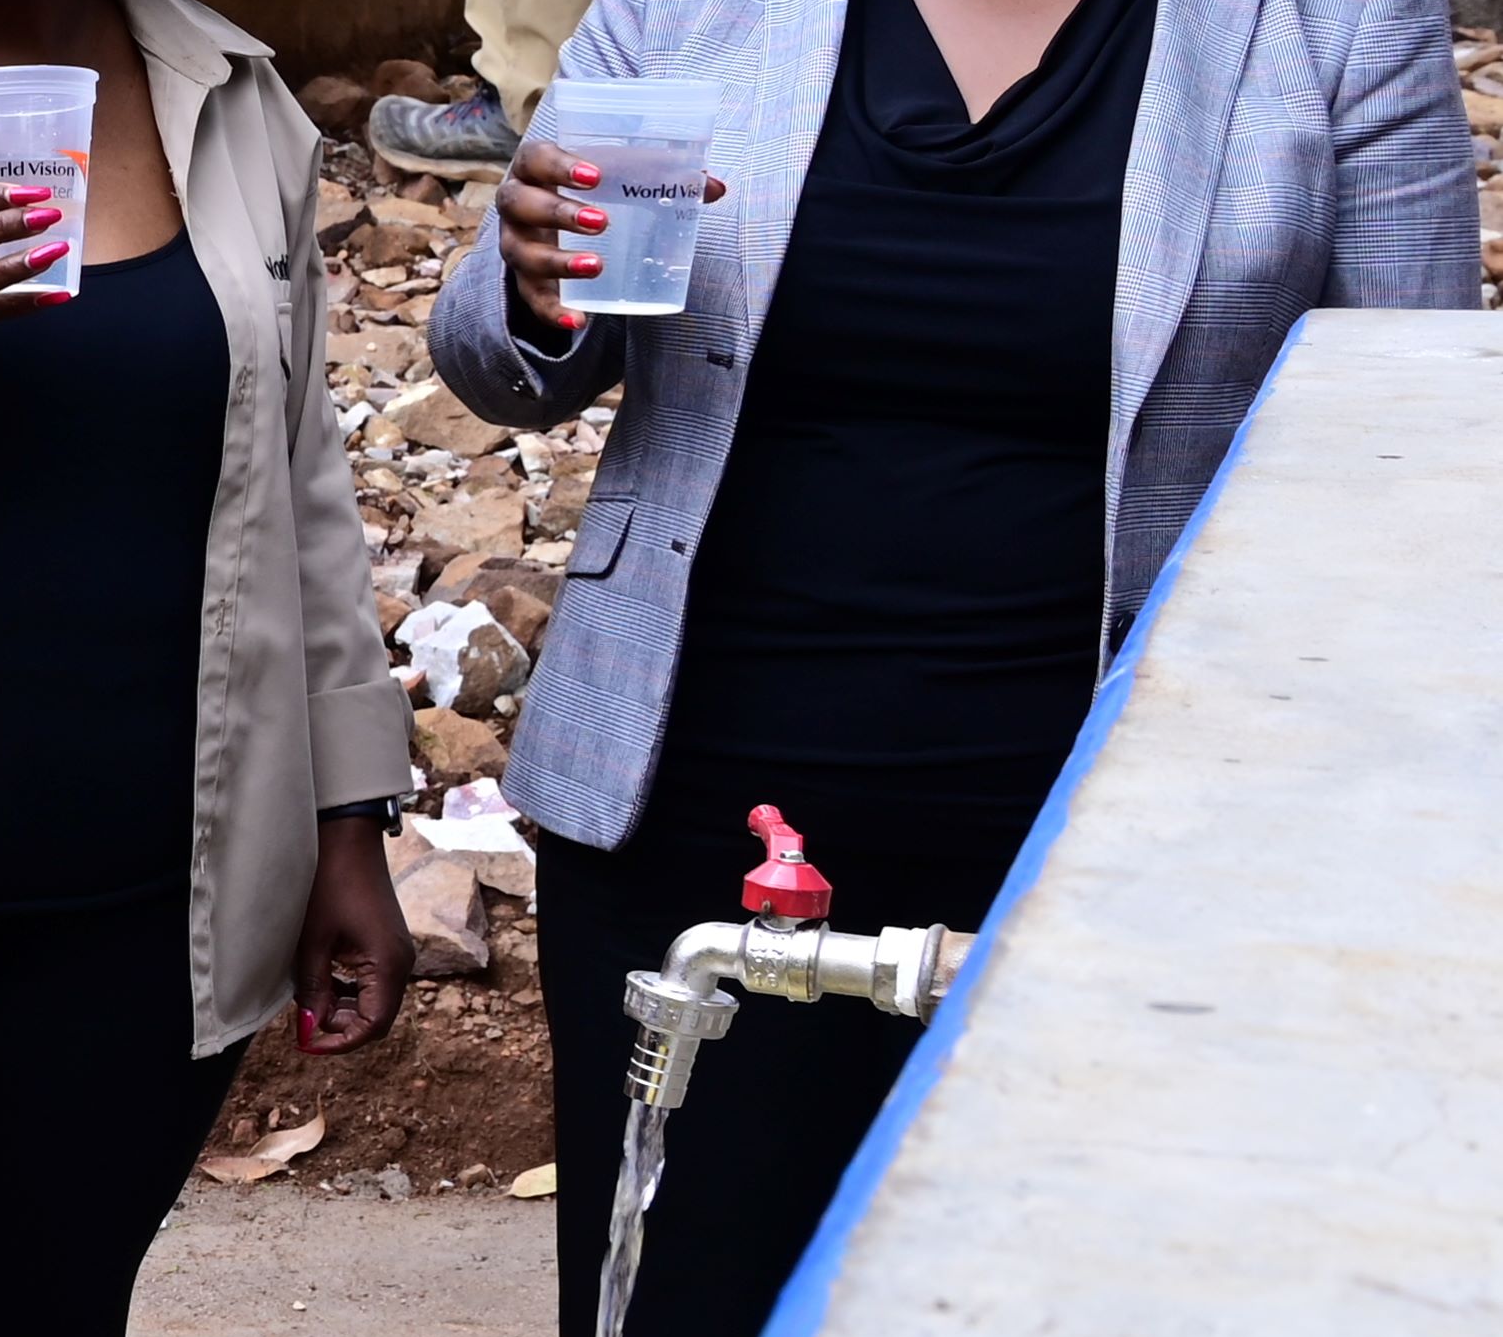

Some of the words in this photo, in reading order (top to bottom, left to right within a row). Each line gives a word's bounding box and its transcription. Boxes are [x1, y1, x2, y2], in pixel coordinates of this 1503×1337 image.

[28, 162, 75, 178] Vision
[52, 184, 73, 199] ter
[621, 183, 677, 199] World
